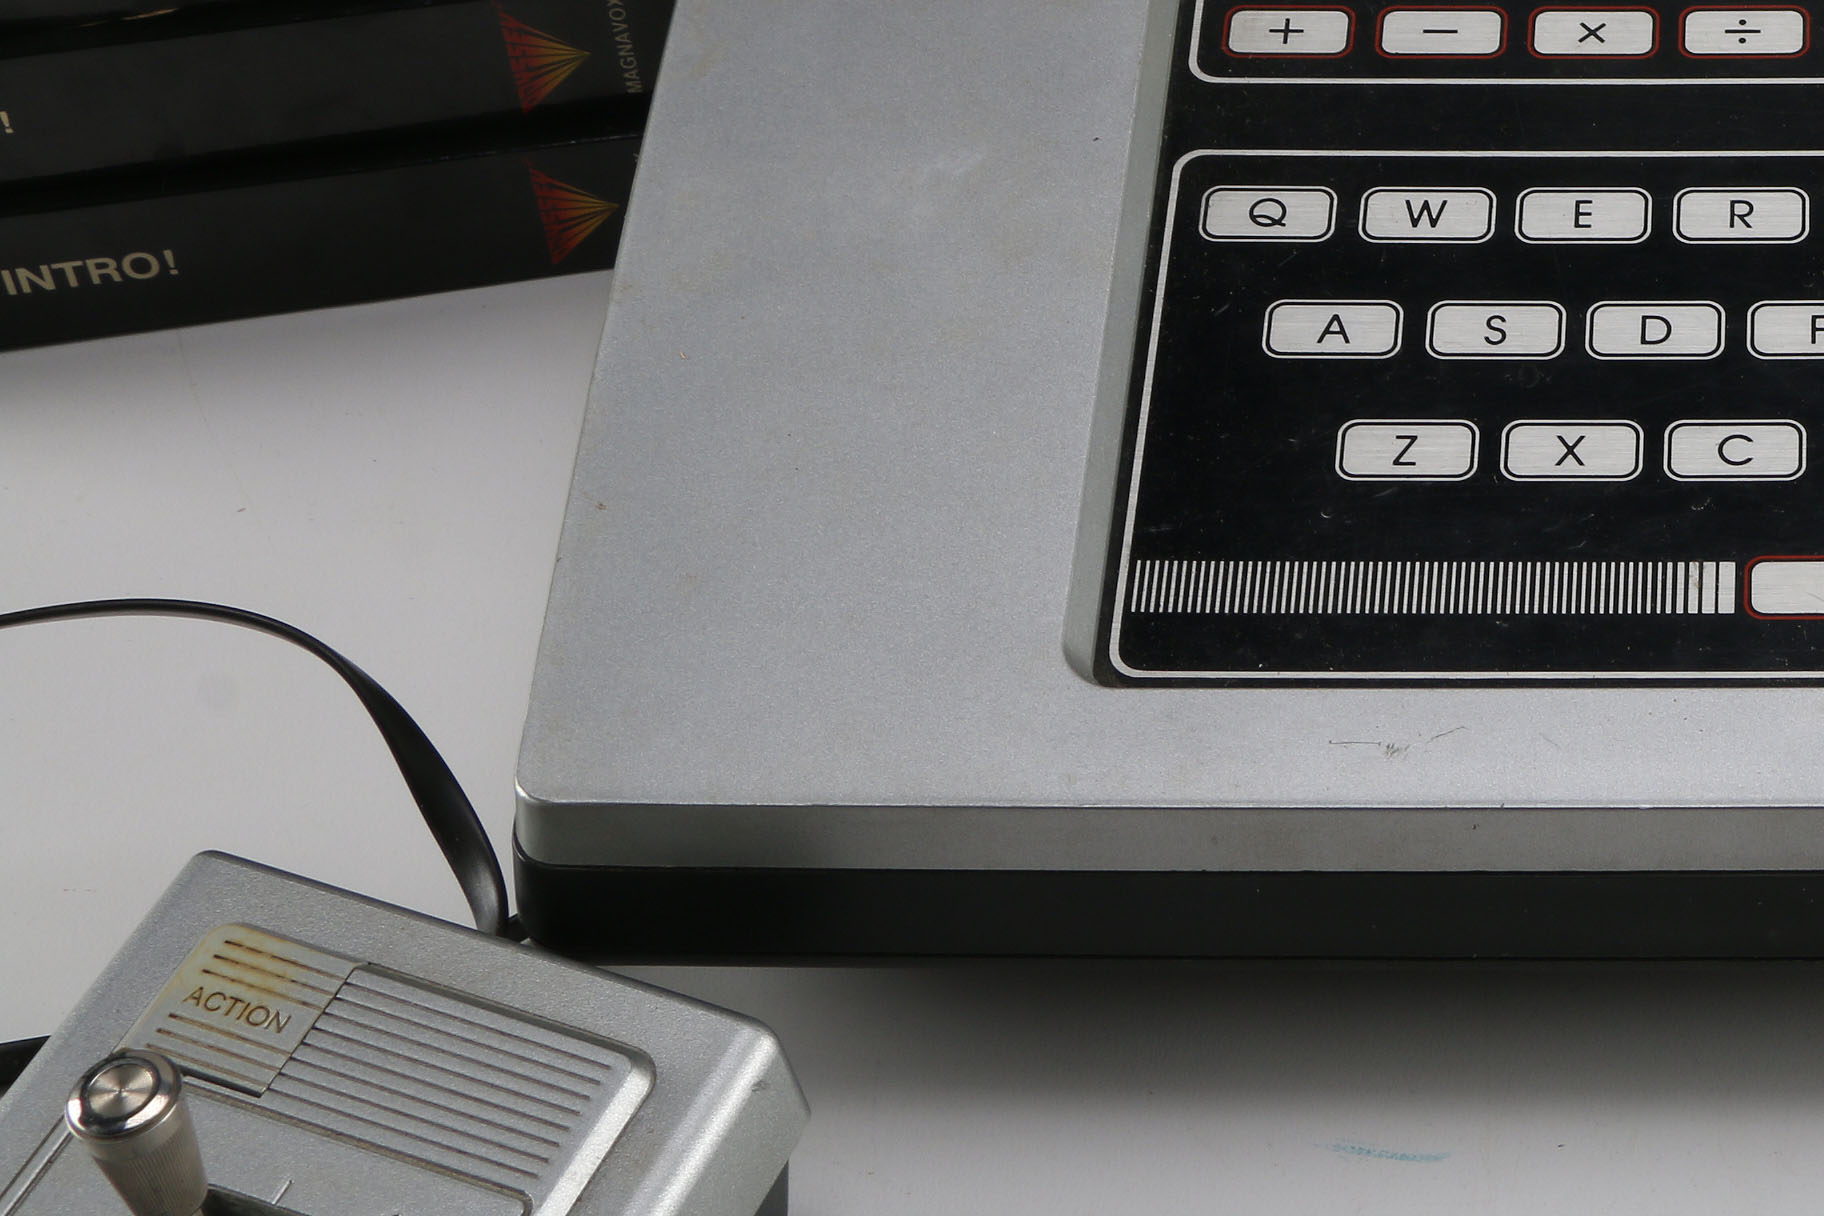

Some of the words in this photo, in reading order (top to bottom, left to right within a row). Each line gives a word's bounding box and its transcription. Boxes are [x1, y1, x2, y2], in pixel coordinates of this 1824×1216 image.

[1248, 197, 1287, 228] Q
[1405, 199, 1448, 229] W
[1574, 199, 1593, 229] E
[1729, 199, 1754, 229] R
[0, 248, 180, 296] INTRO!
[1316, 313, 1351, 344] A
[1484, 314, 1507, 346] S
[1640, 315, 1672, 345] D
[1392, 434, 1418, 466] Z
[1554, 435, 1586, 466] X
[1717, 434, 1754, 466] C
[183, 986, 292, 1035] ACTION
